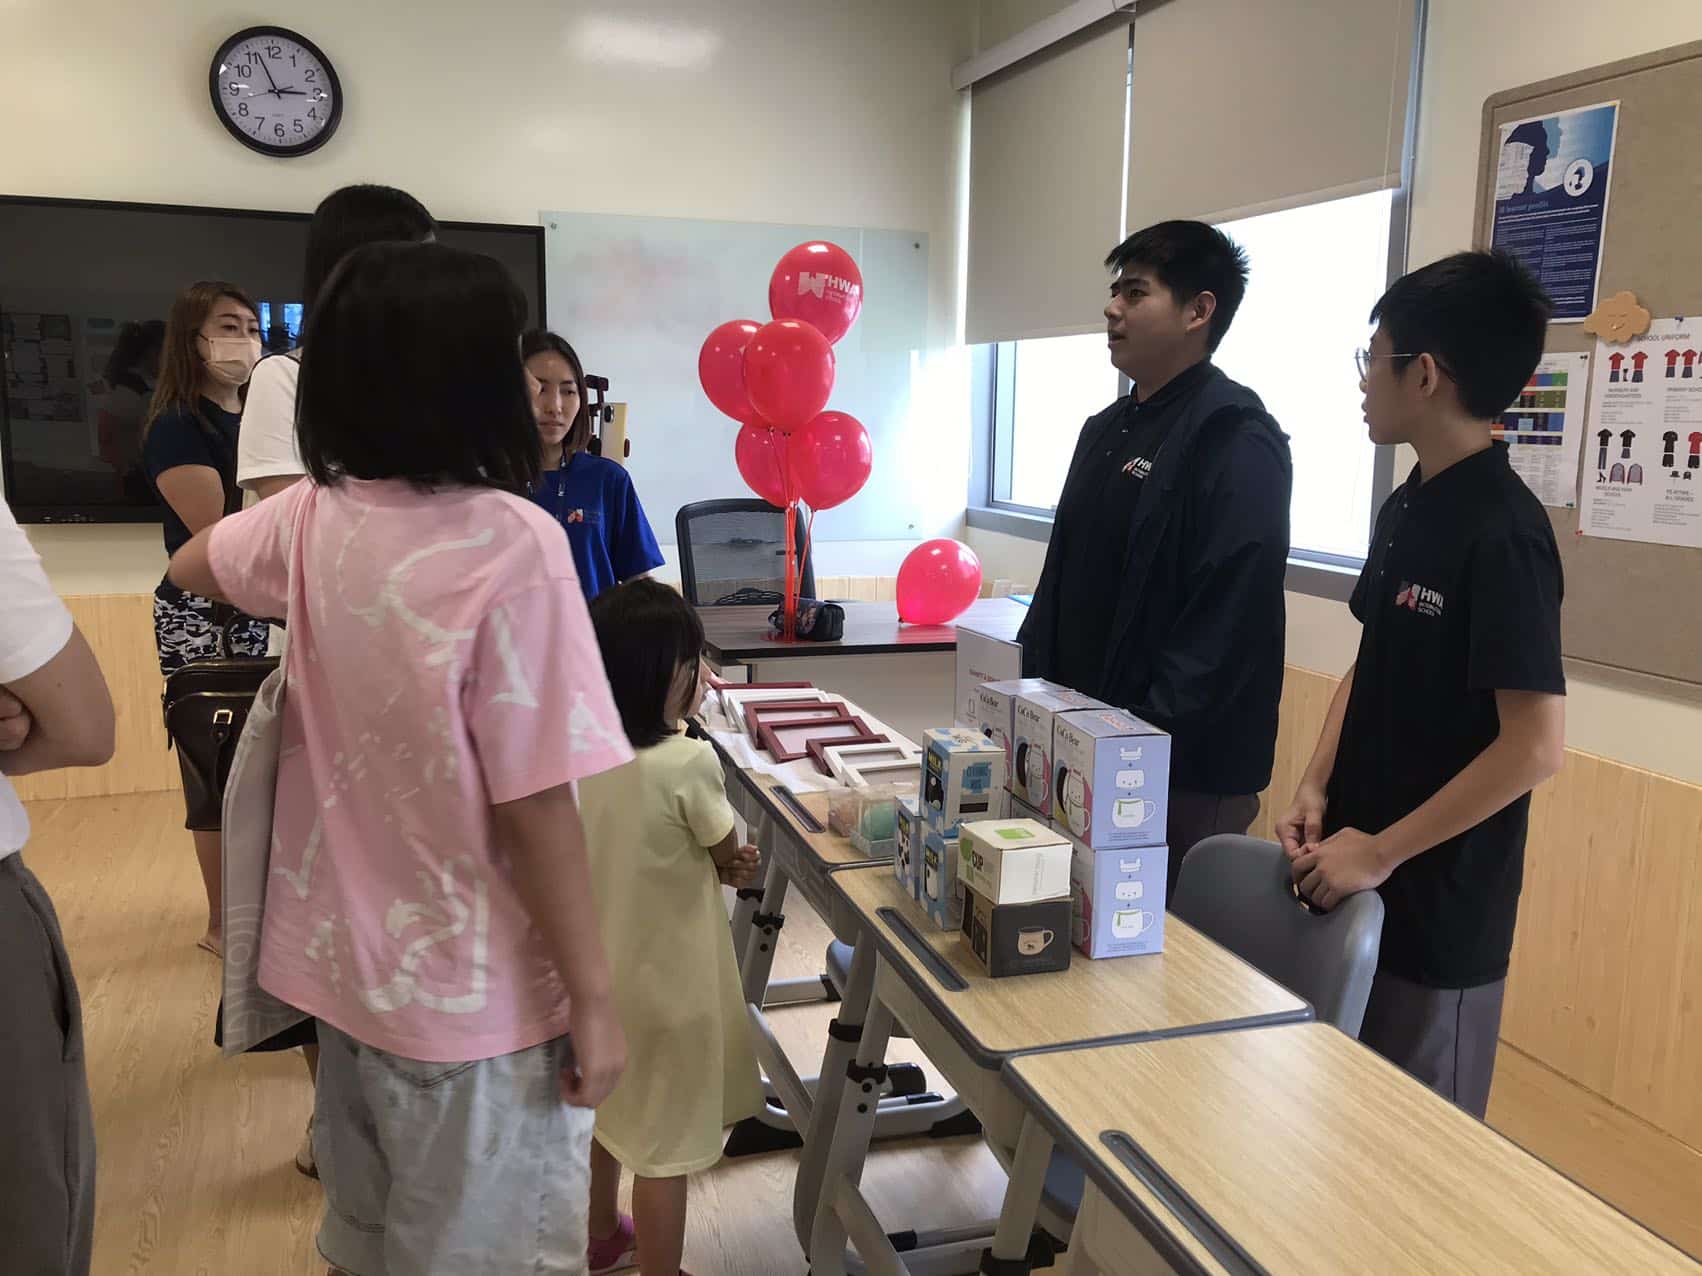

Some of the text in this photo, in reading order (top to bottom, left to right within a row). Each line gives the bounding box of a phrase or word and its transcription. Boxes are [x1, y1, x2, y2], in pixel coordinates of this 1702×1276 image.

[245, 52, 258, 64] 11
[264, 46, 281, 59] 12
[289, 55, 296, 67] 1
[235, 65, 251, 78] 10
[304, 69, 315, 82] 2
[229, 83, 239, 96] 9
[312, 88, 323, 102] 3
[238, 103, 249, 117] 8
[307, 108, 316, 120] 4
[255, 117, 265, 131] 7
[274, 124, 285, 137] 6
[294, 120, 304, 133] 5
